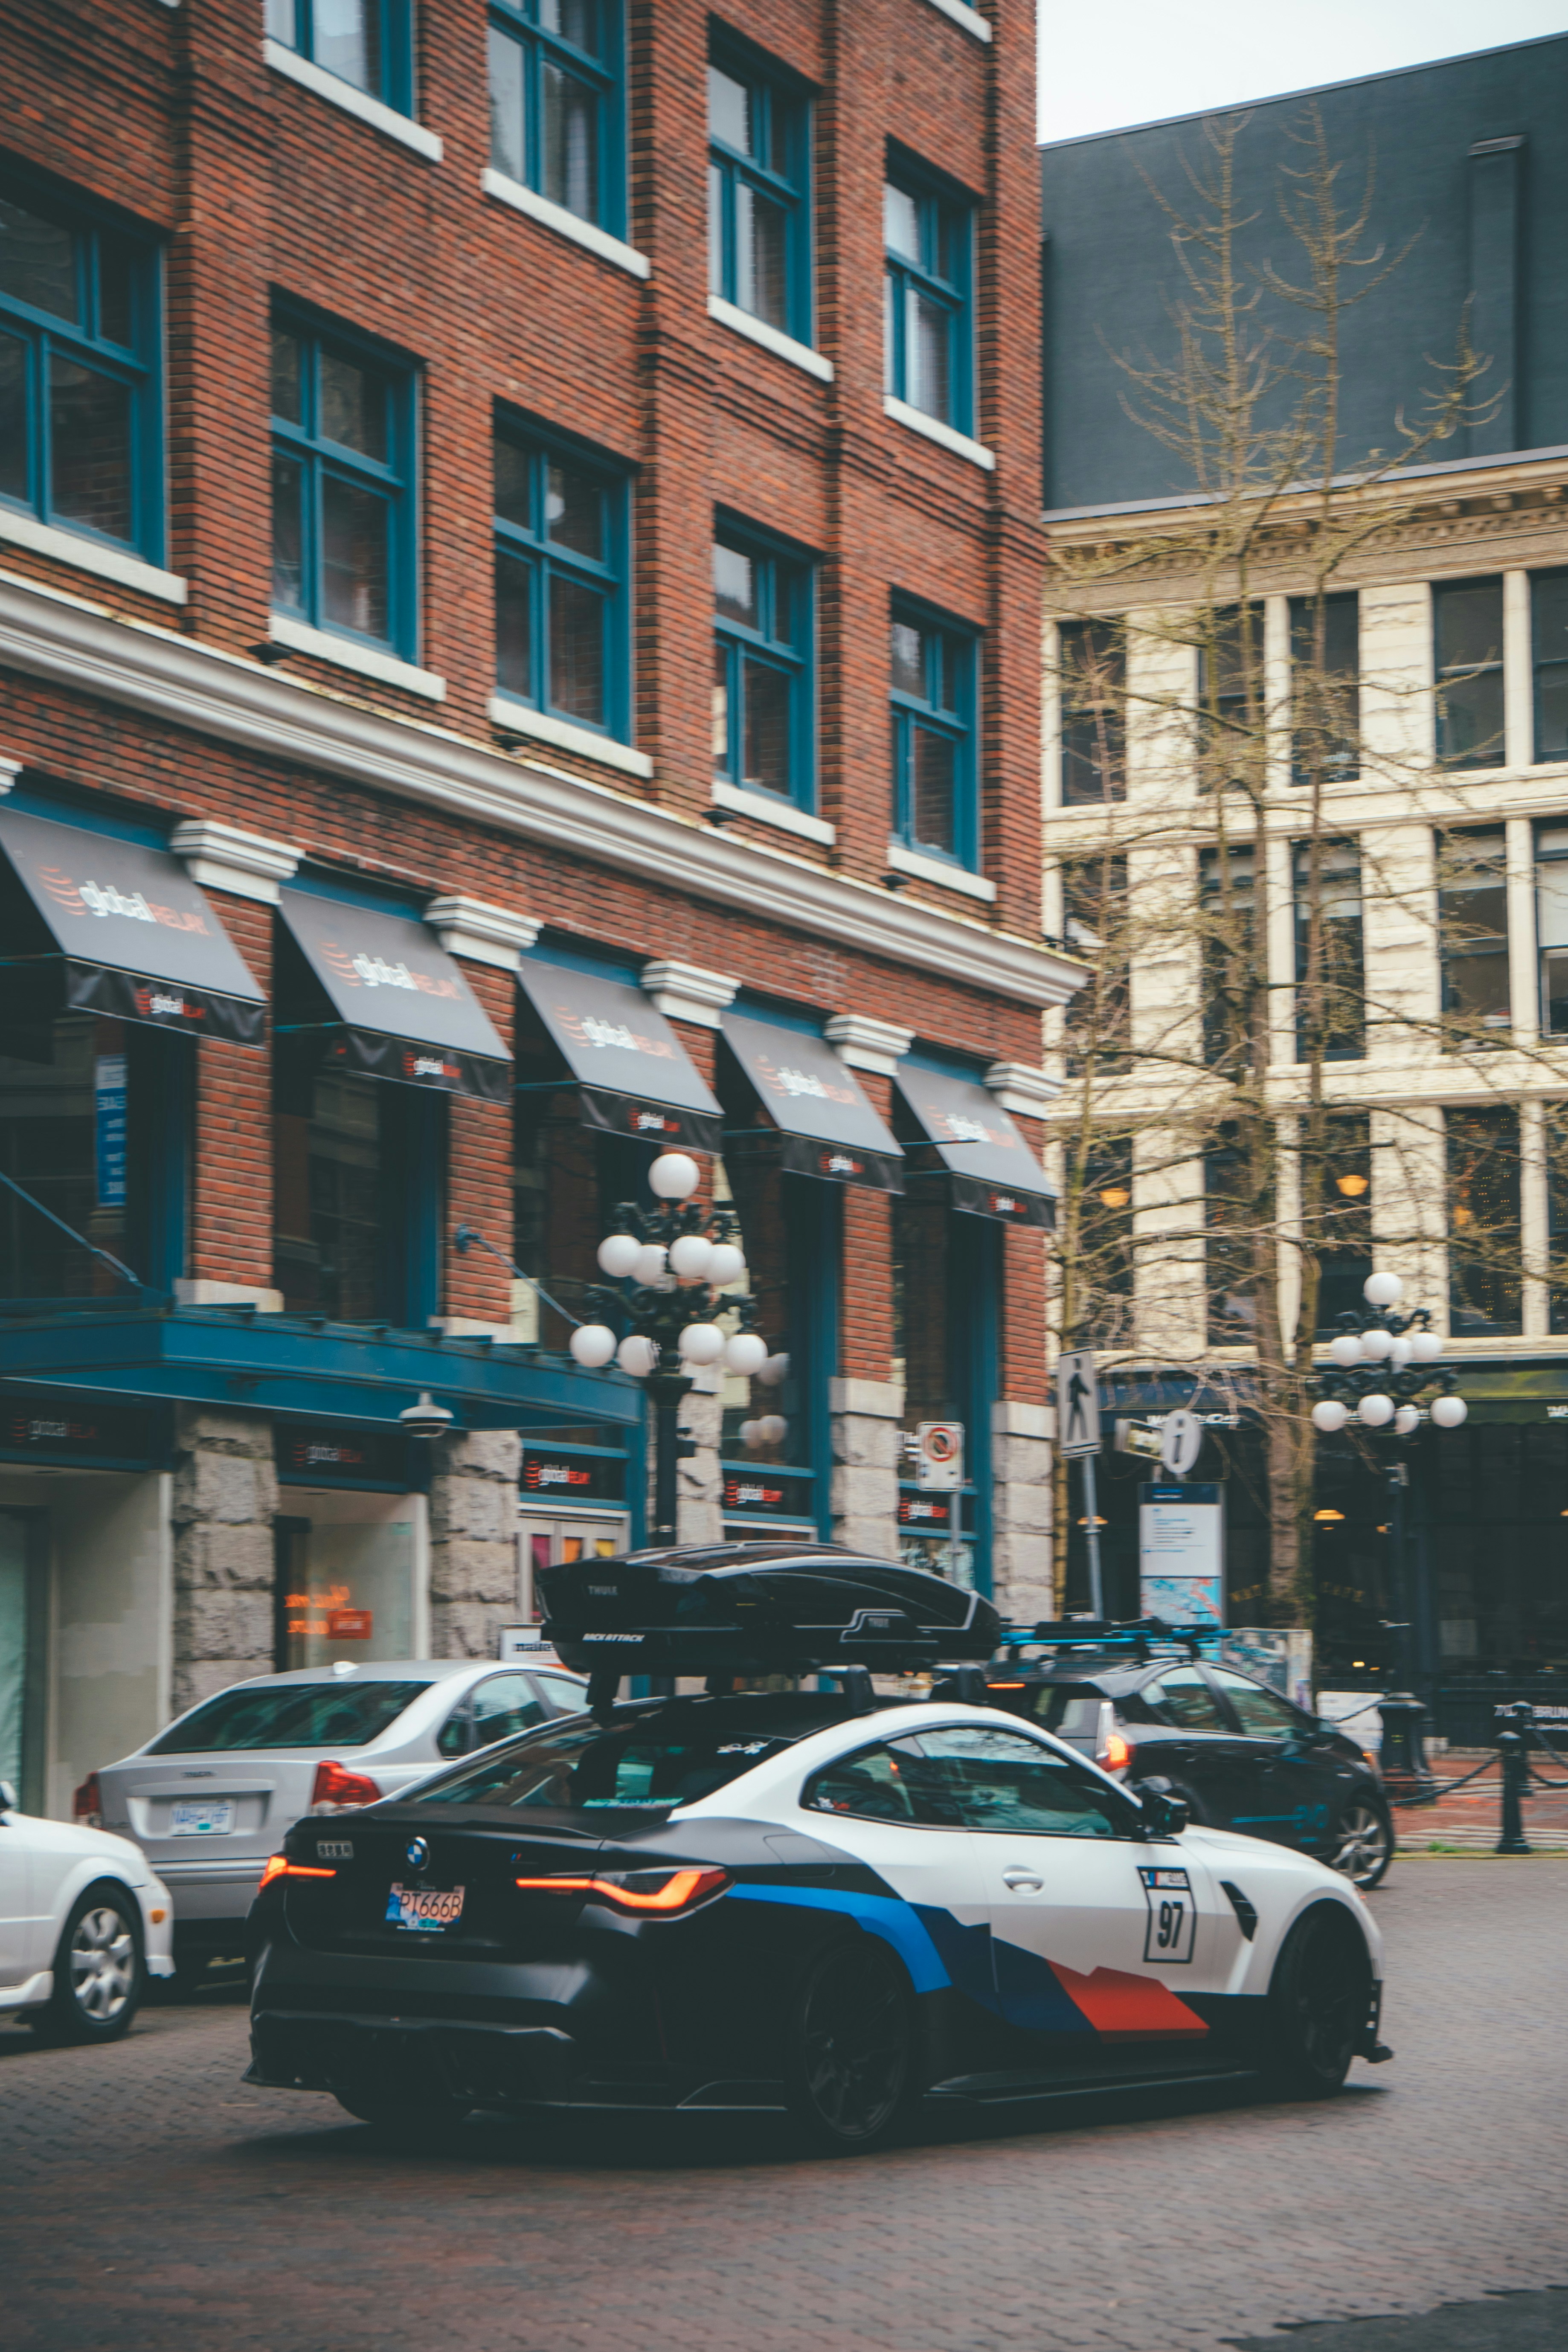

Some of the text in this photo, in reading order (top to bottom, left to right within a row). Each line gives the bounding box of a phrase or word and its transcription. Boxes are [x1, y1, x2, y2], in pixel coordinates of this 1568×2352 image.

[80, 880, 156, 922] global
[353, 954, 418, 990] global
[581, 1016, 639, 1050] global
[538, 1464, 570, 1486] global
[736, 1479, 764, 1504] global
[588, 1585, 618, 1595] THULE
[605, 1634, 645, 1642] ATTACK
[399, 1892, 462, 1918] PT666B
[1157, 1900, 1184, 1948] 97
